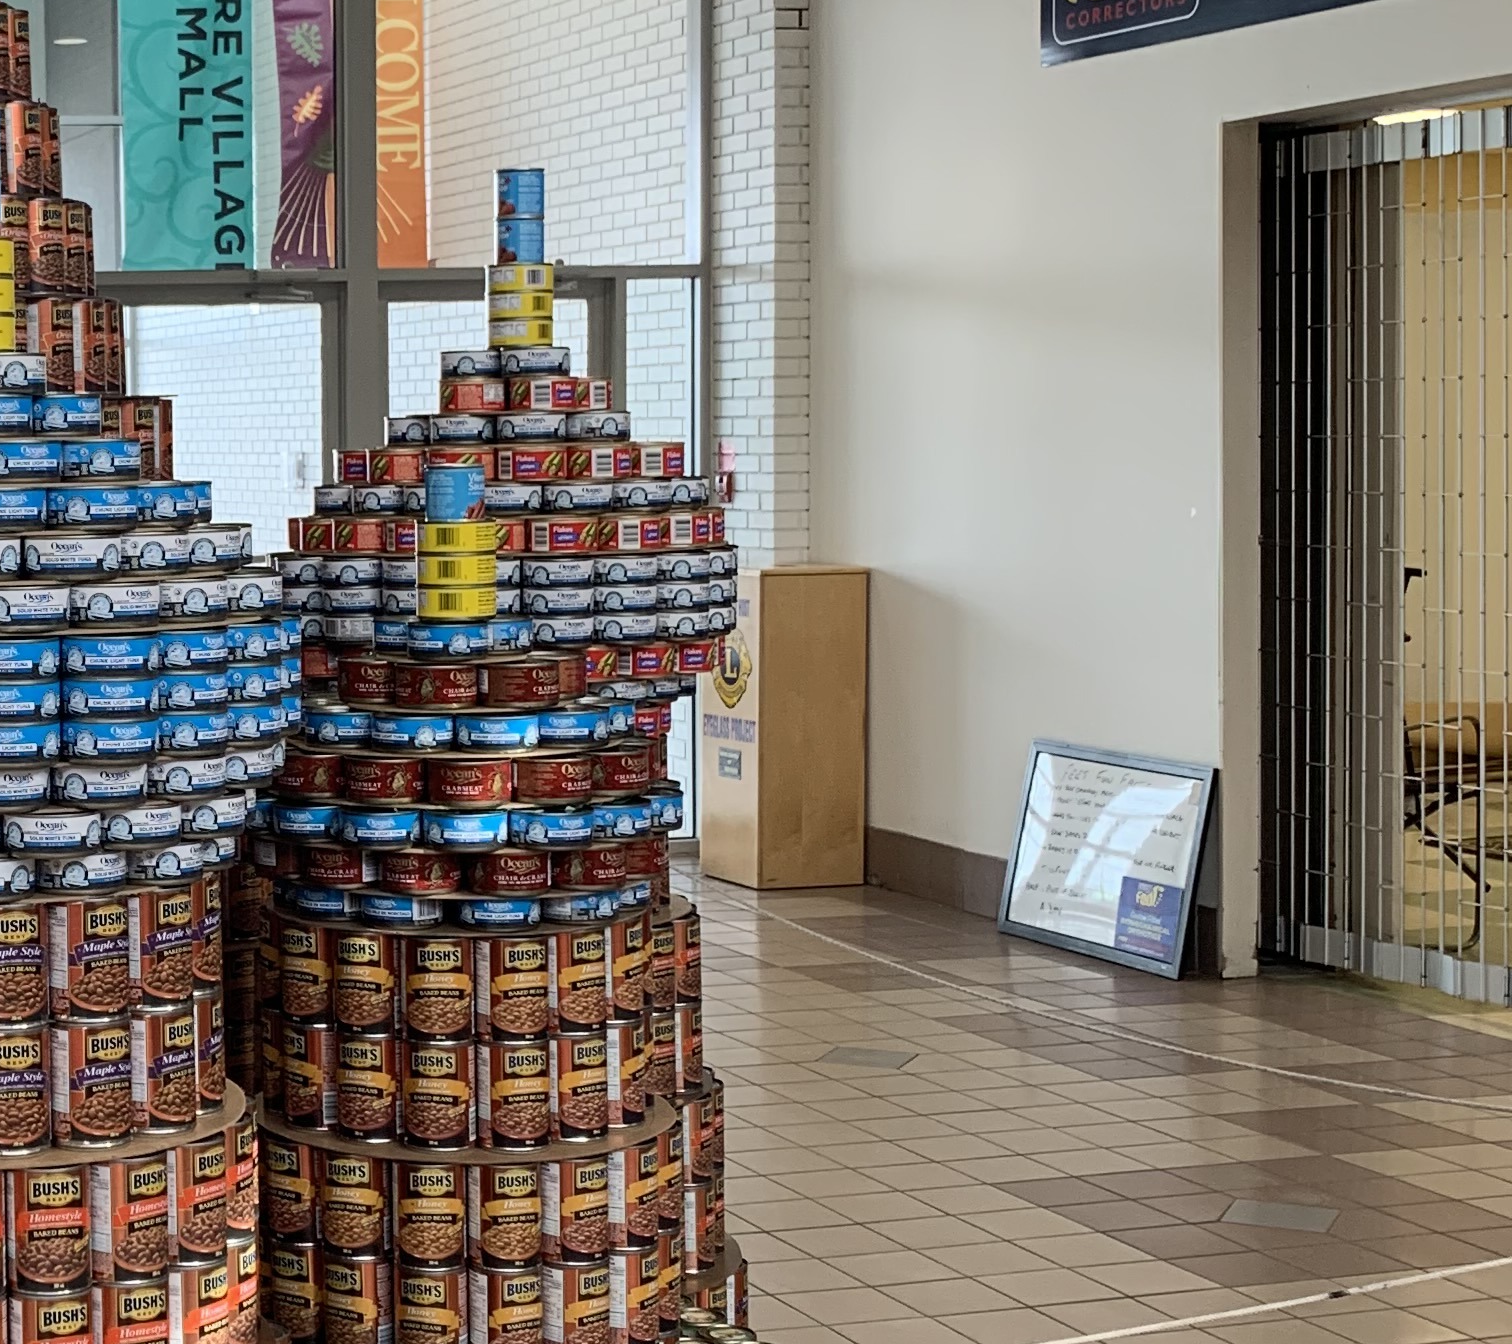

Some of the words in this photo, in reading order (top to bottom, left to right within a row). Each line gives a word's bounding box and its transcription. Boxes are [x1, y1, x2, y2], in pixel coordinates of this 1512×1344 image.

[176, 8, 207, 141] MALL
[731, 718, 756, 743] PROJECT
[419, 948, 460, 965] BUSH'S
[425, 973, 456, 986] Honey
[412, 1052, 455, 1069] BUSH'S
[410, 1173, 453, 1190] BUSH'S
[498, 1173, 536, 1189] BUSH'S
[30, 1180, 80, 1200] BUSH'S
[415, 1197, 448, 1209] Honey
[29, 1210, 83, 1225] Homestyle
